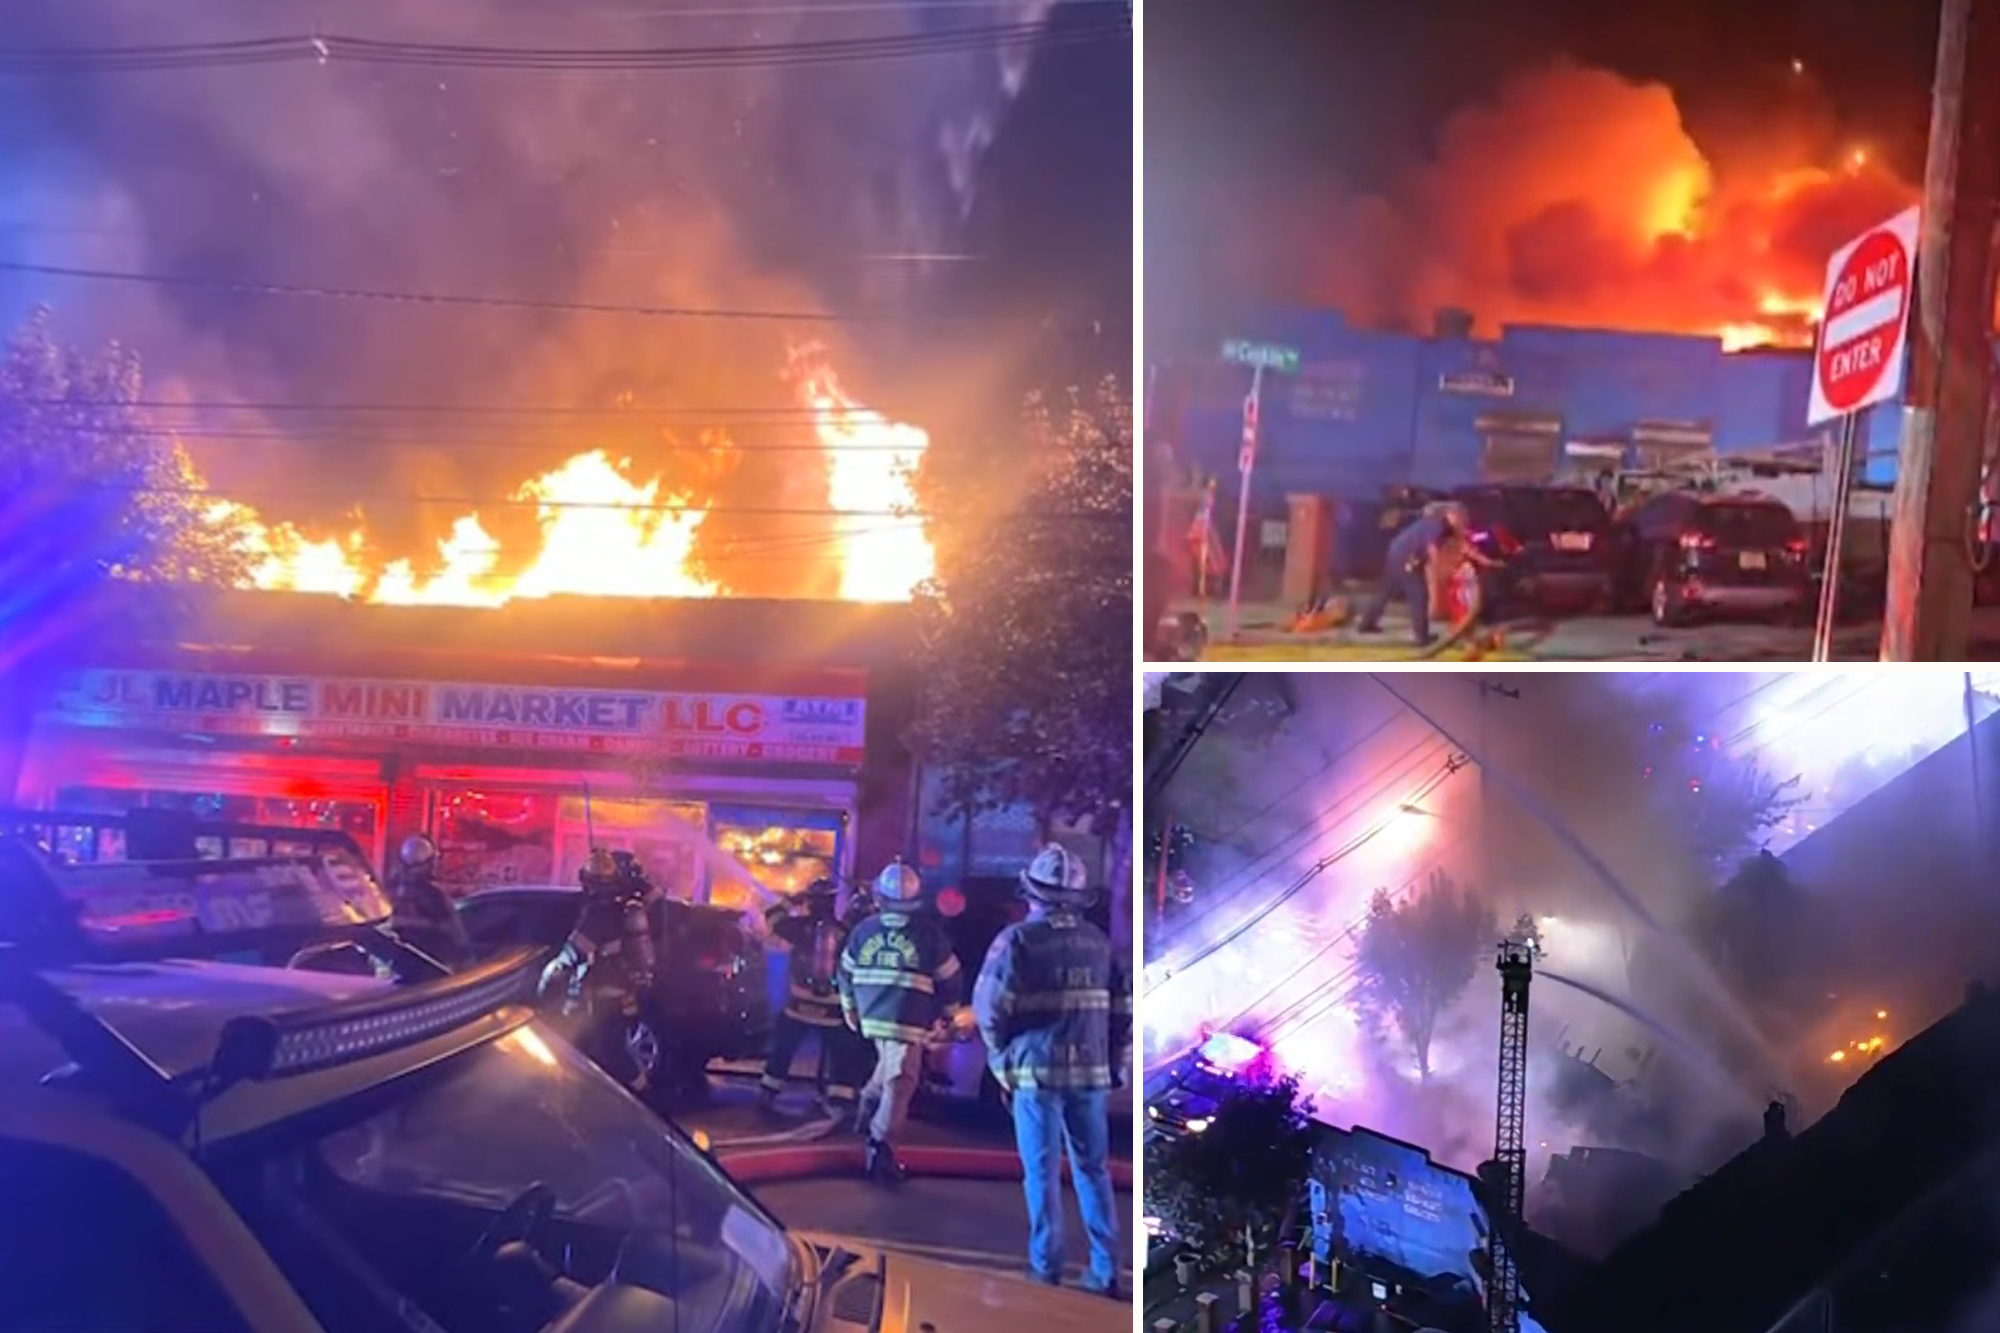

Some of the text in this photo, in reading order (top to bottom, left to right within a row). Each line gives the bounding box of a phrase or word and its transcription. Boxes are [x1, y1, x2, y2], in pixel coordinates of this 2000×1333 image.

[1834, 250, 1899, 307] DO NOT
[1830, 337, 1883, 383] ENTER
[153, 678, 308, 713] MAPLE
[323, 684, 426, 718] MINI
[440, 690, 648, 728] MARKET
[663, 700, 764, 734] LLC
[877, 950, 900, 968] FIRE
